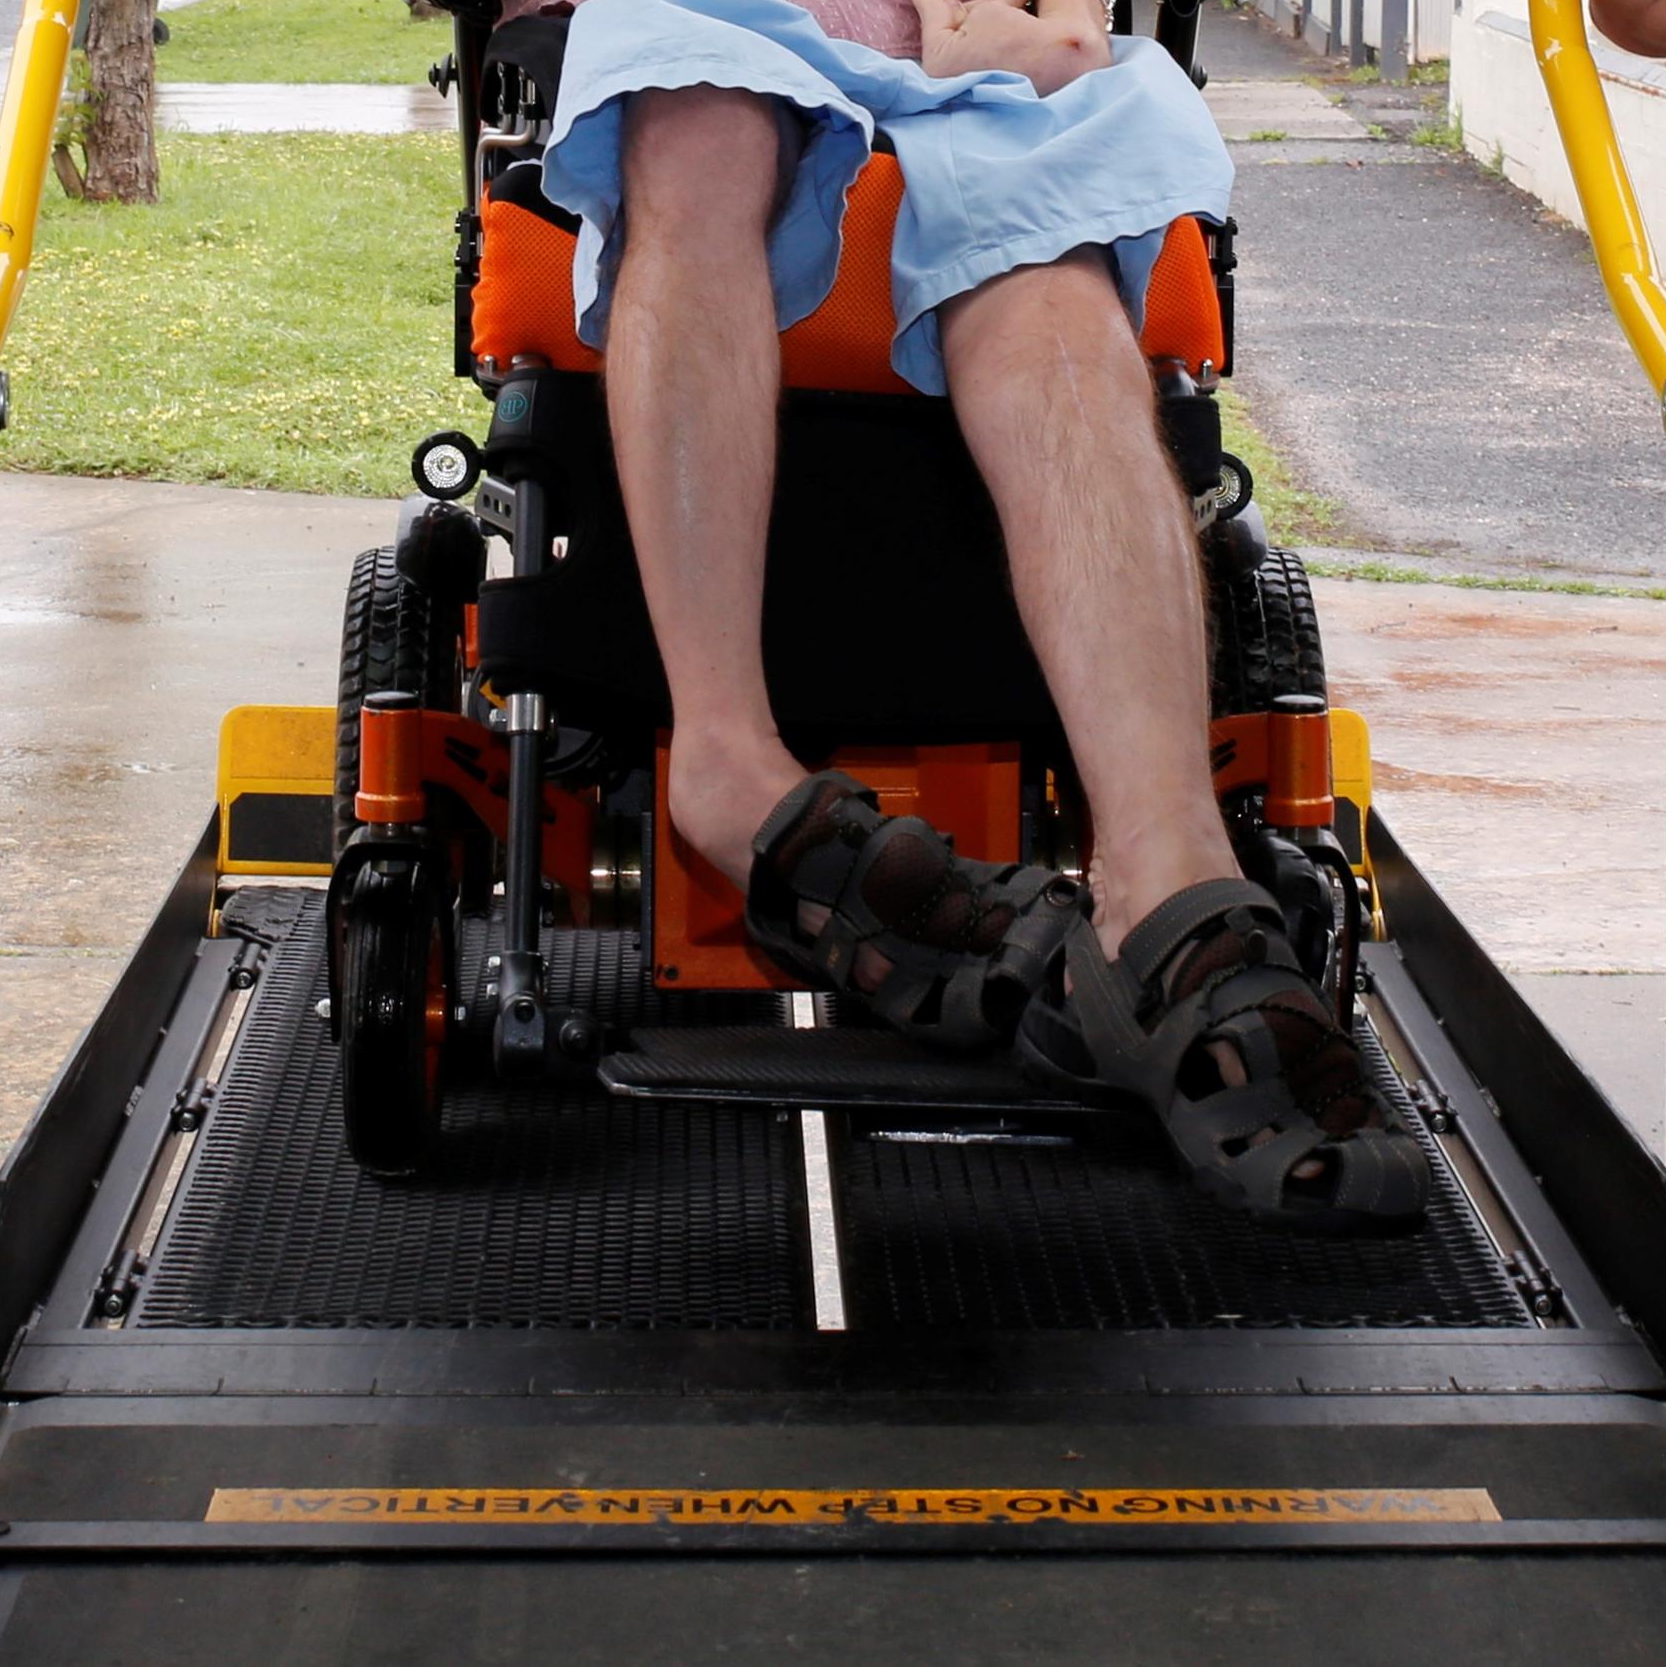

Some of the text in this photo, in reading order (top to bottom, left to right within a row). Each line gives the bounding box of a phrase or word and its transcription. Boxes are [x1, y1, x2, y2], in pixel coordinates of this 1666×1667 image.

[252, 1496, 1443, 1514] WARNING NO STEP WHEN VERTICAL
